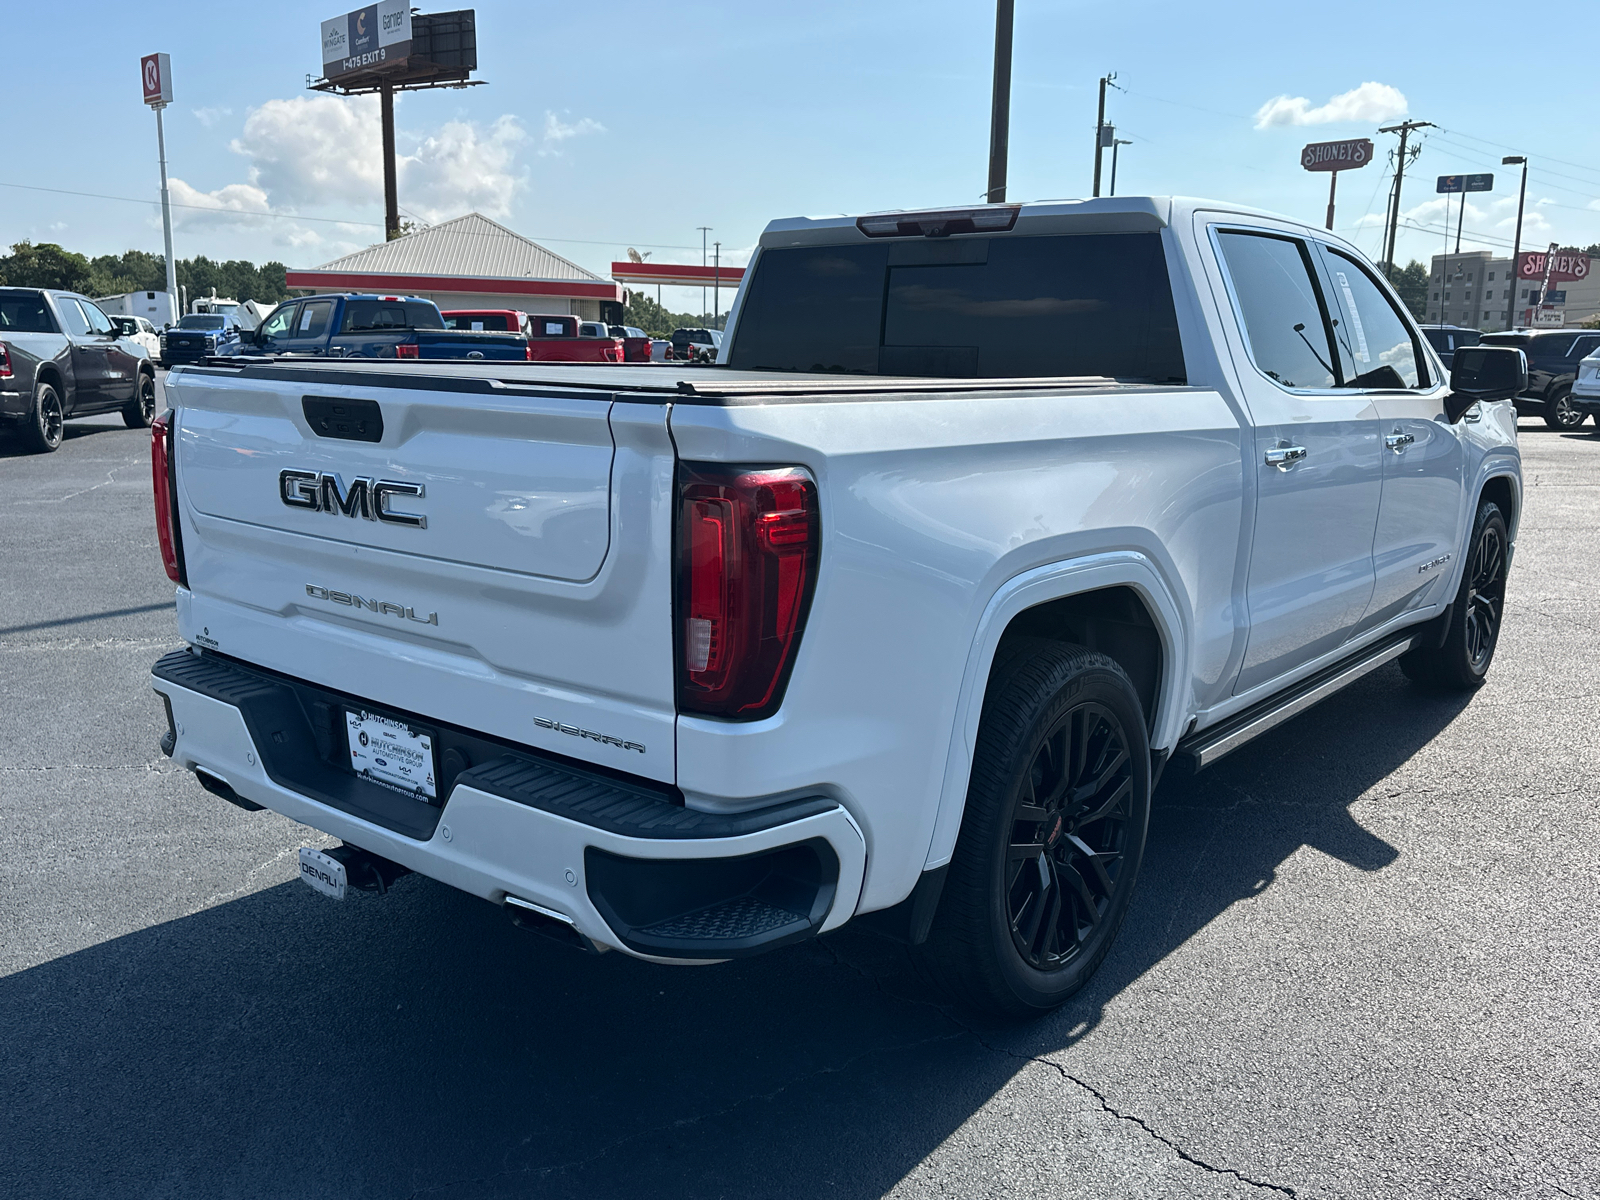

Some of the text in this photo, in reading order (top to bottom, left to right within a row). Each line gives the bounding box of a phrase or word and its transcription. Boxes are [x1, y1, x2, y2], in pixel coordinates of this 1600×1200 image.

[324, 33, 346, 49] WINGATE
[342, 48, 386, 70] I-475 EXIT 9
[147, 65, 156, 85] K
[1304, 141, 1365, 166] SHONEY'S
[1523, 255, 1586, 277] SHNEY'S
[279, 466, 428, 529] GMC
[305, 582, 439, 626] DENALI
[368, 712, 409, 732] HUTCHINSON
[533, 715, 646, 754] SIERRA
[370, 736, 424, 762] HUTCHINSON
[372, 748, 405, 763] AUTOMOTIVE
[405, 756, 423, 768] GROUP
[301, 862, 337, 889] DENALI
